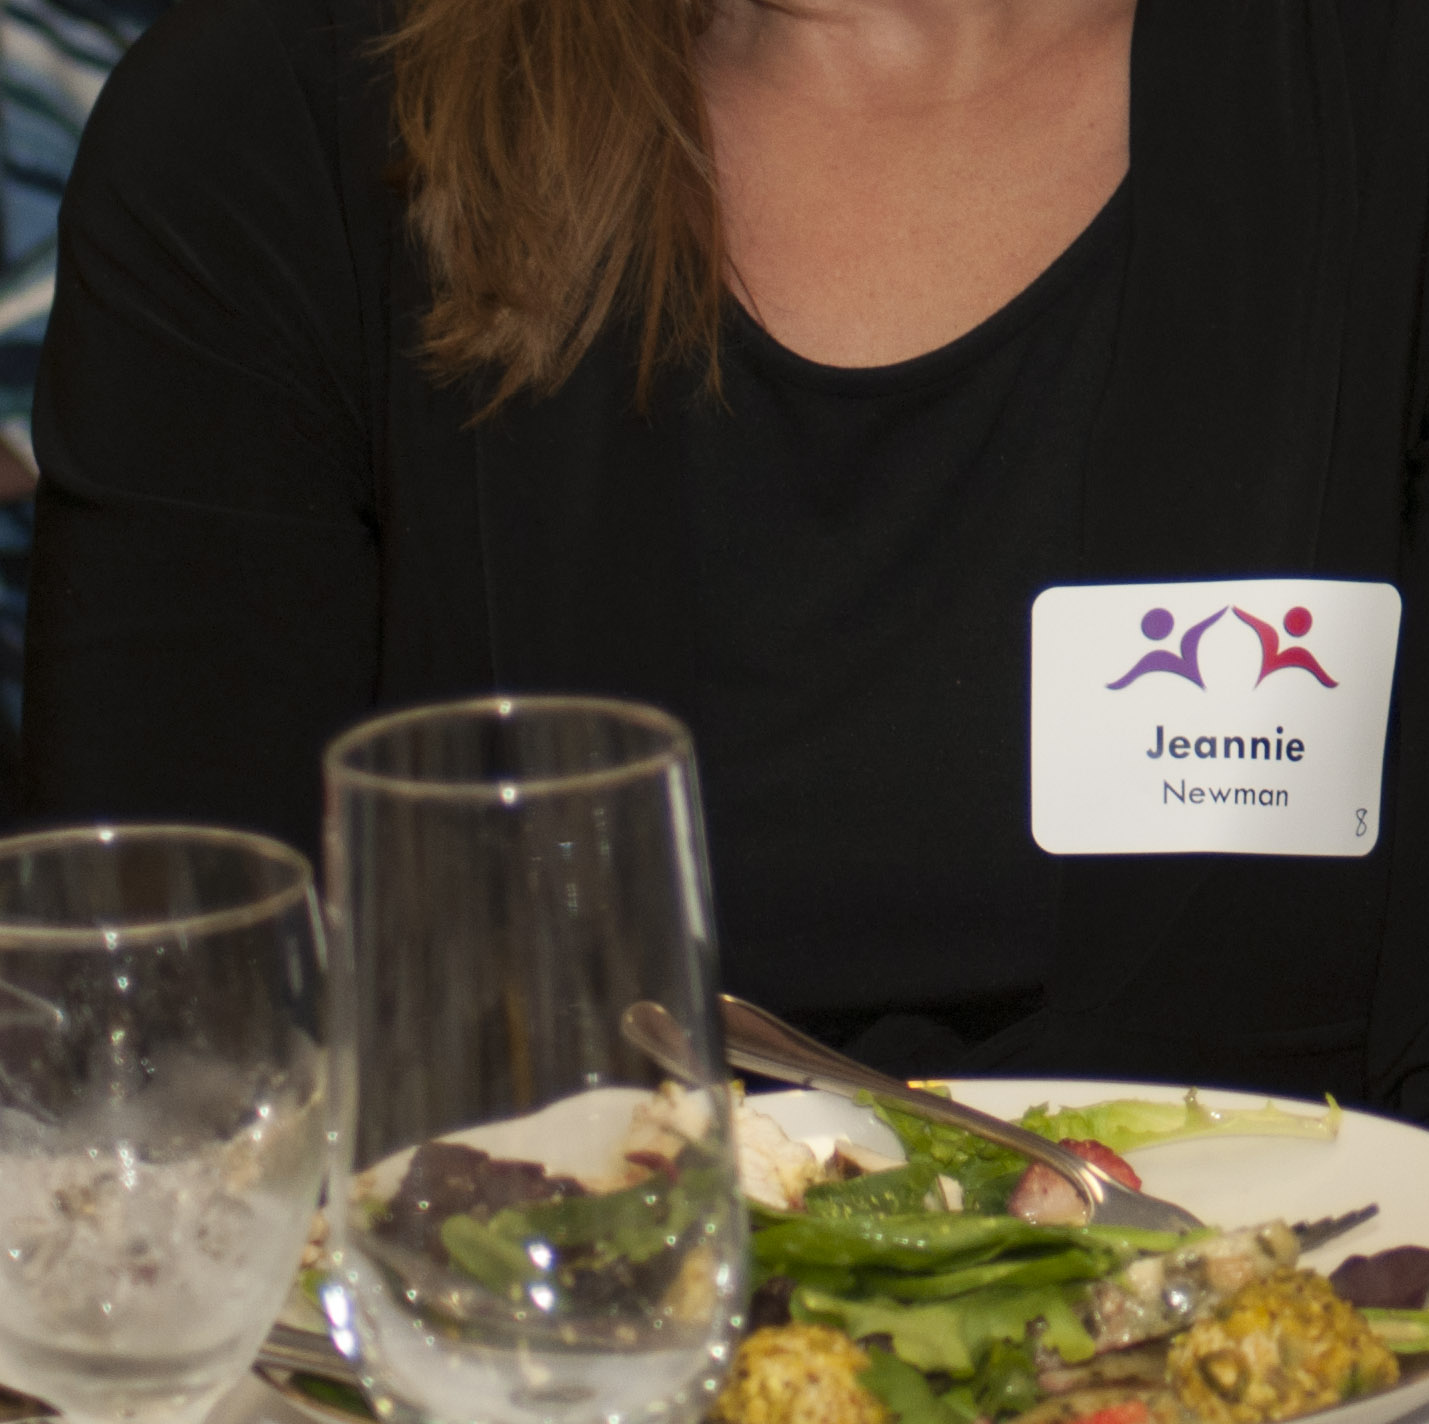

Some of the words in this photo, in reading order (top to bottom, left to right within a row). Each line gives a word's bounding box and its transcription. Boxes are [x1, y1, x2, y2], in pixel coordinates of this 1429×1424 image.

[1146, 725, 1305, 762] Jeannie
[1163, 779, 1289, 807] Newman
[1355, 808, 1368, 837] 8
